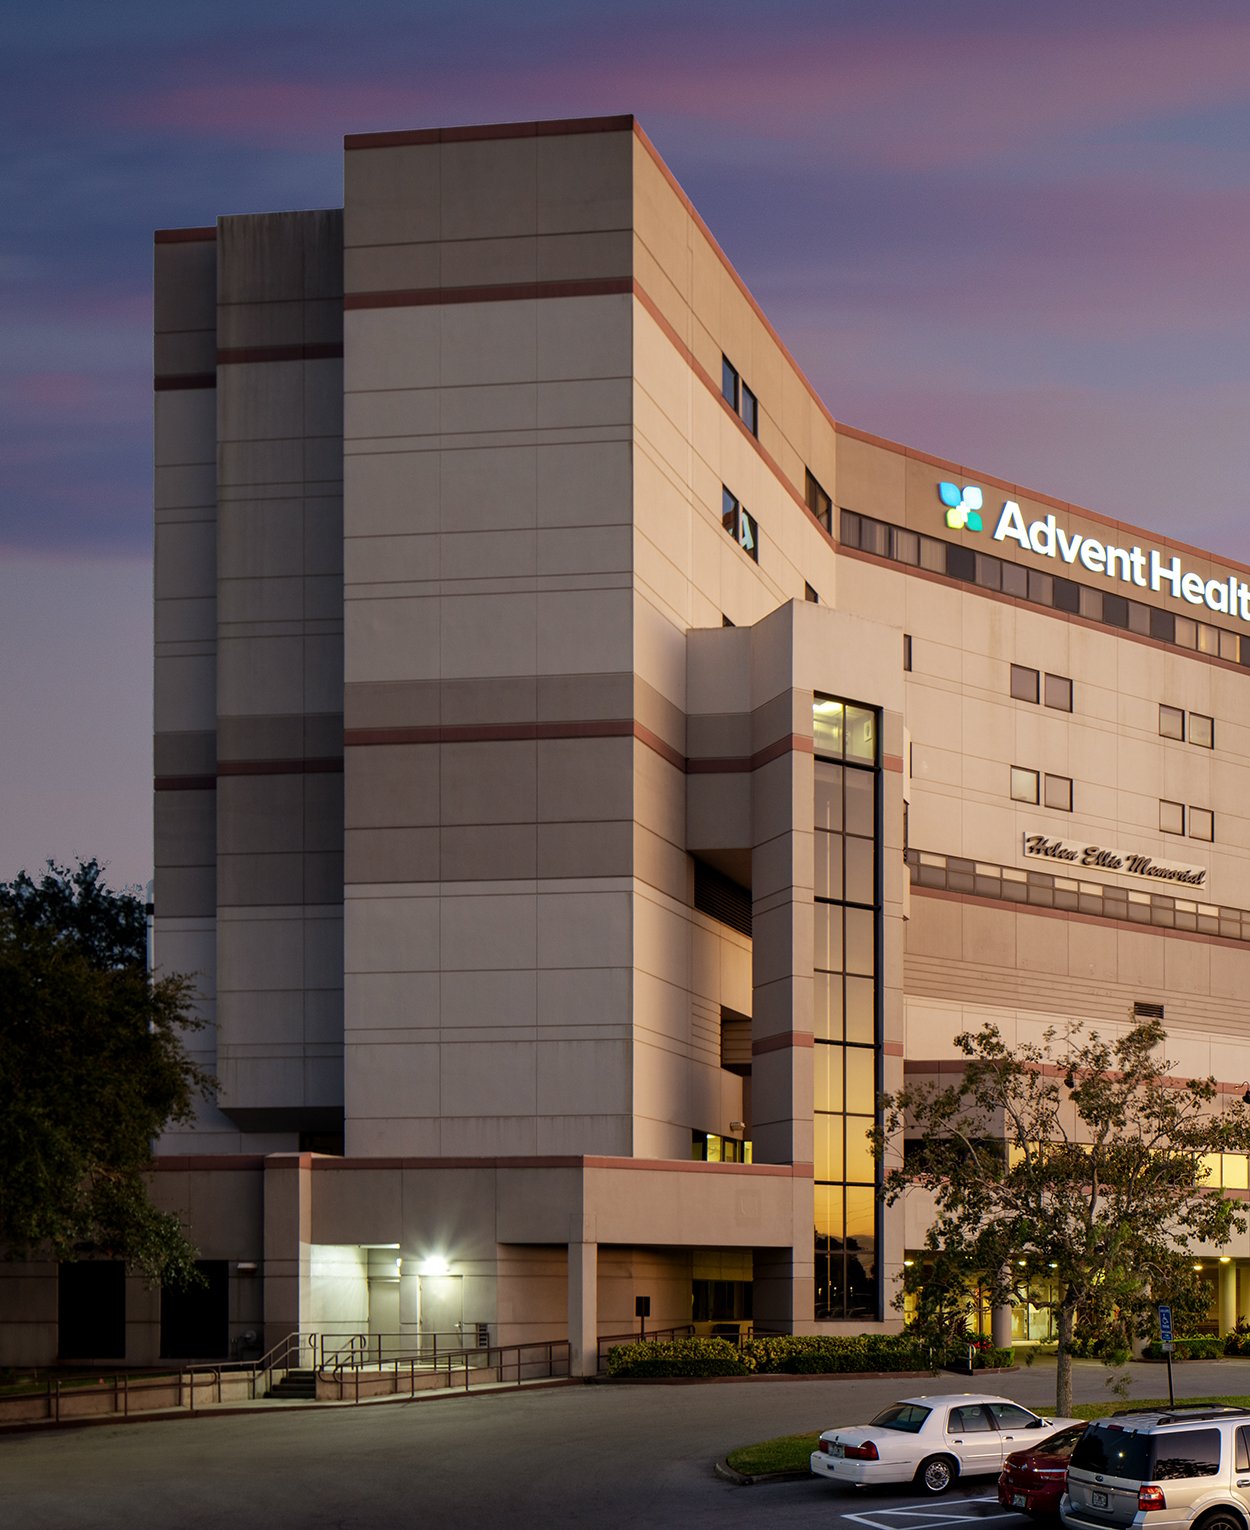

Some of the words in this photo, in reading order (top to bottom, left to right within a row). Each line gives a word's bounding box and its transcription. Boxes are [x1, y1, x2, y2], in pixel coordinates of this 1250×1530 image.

[1026, 835, 1079, 861] Helen
[1081, 846, 1124, 869] Ellis
[1124, 854, 1207, 885] Memorial
